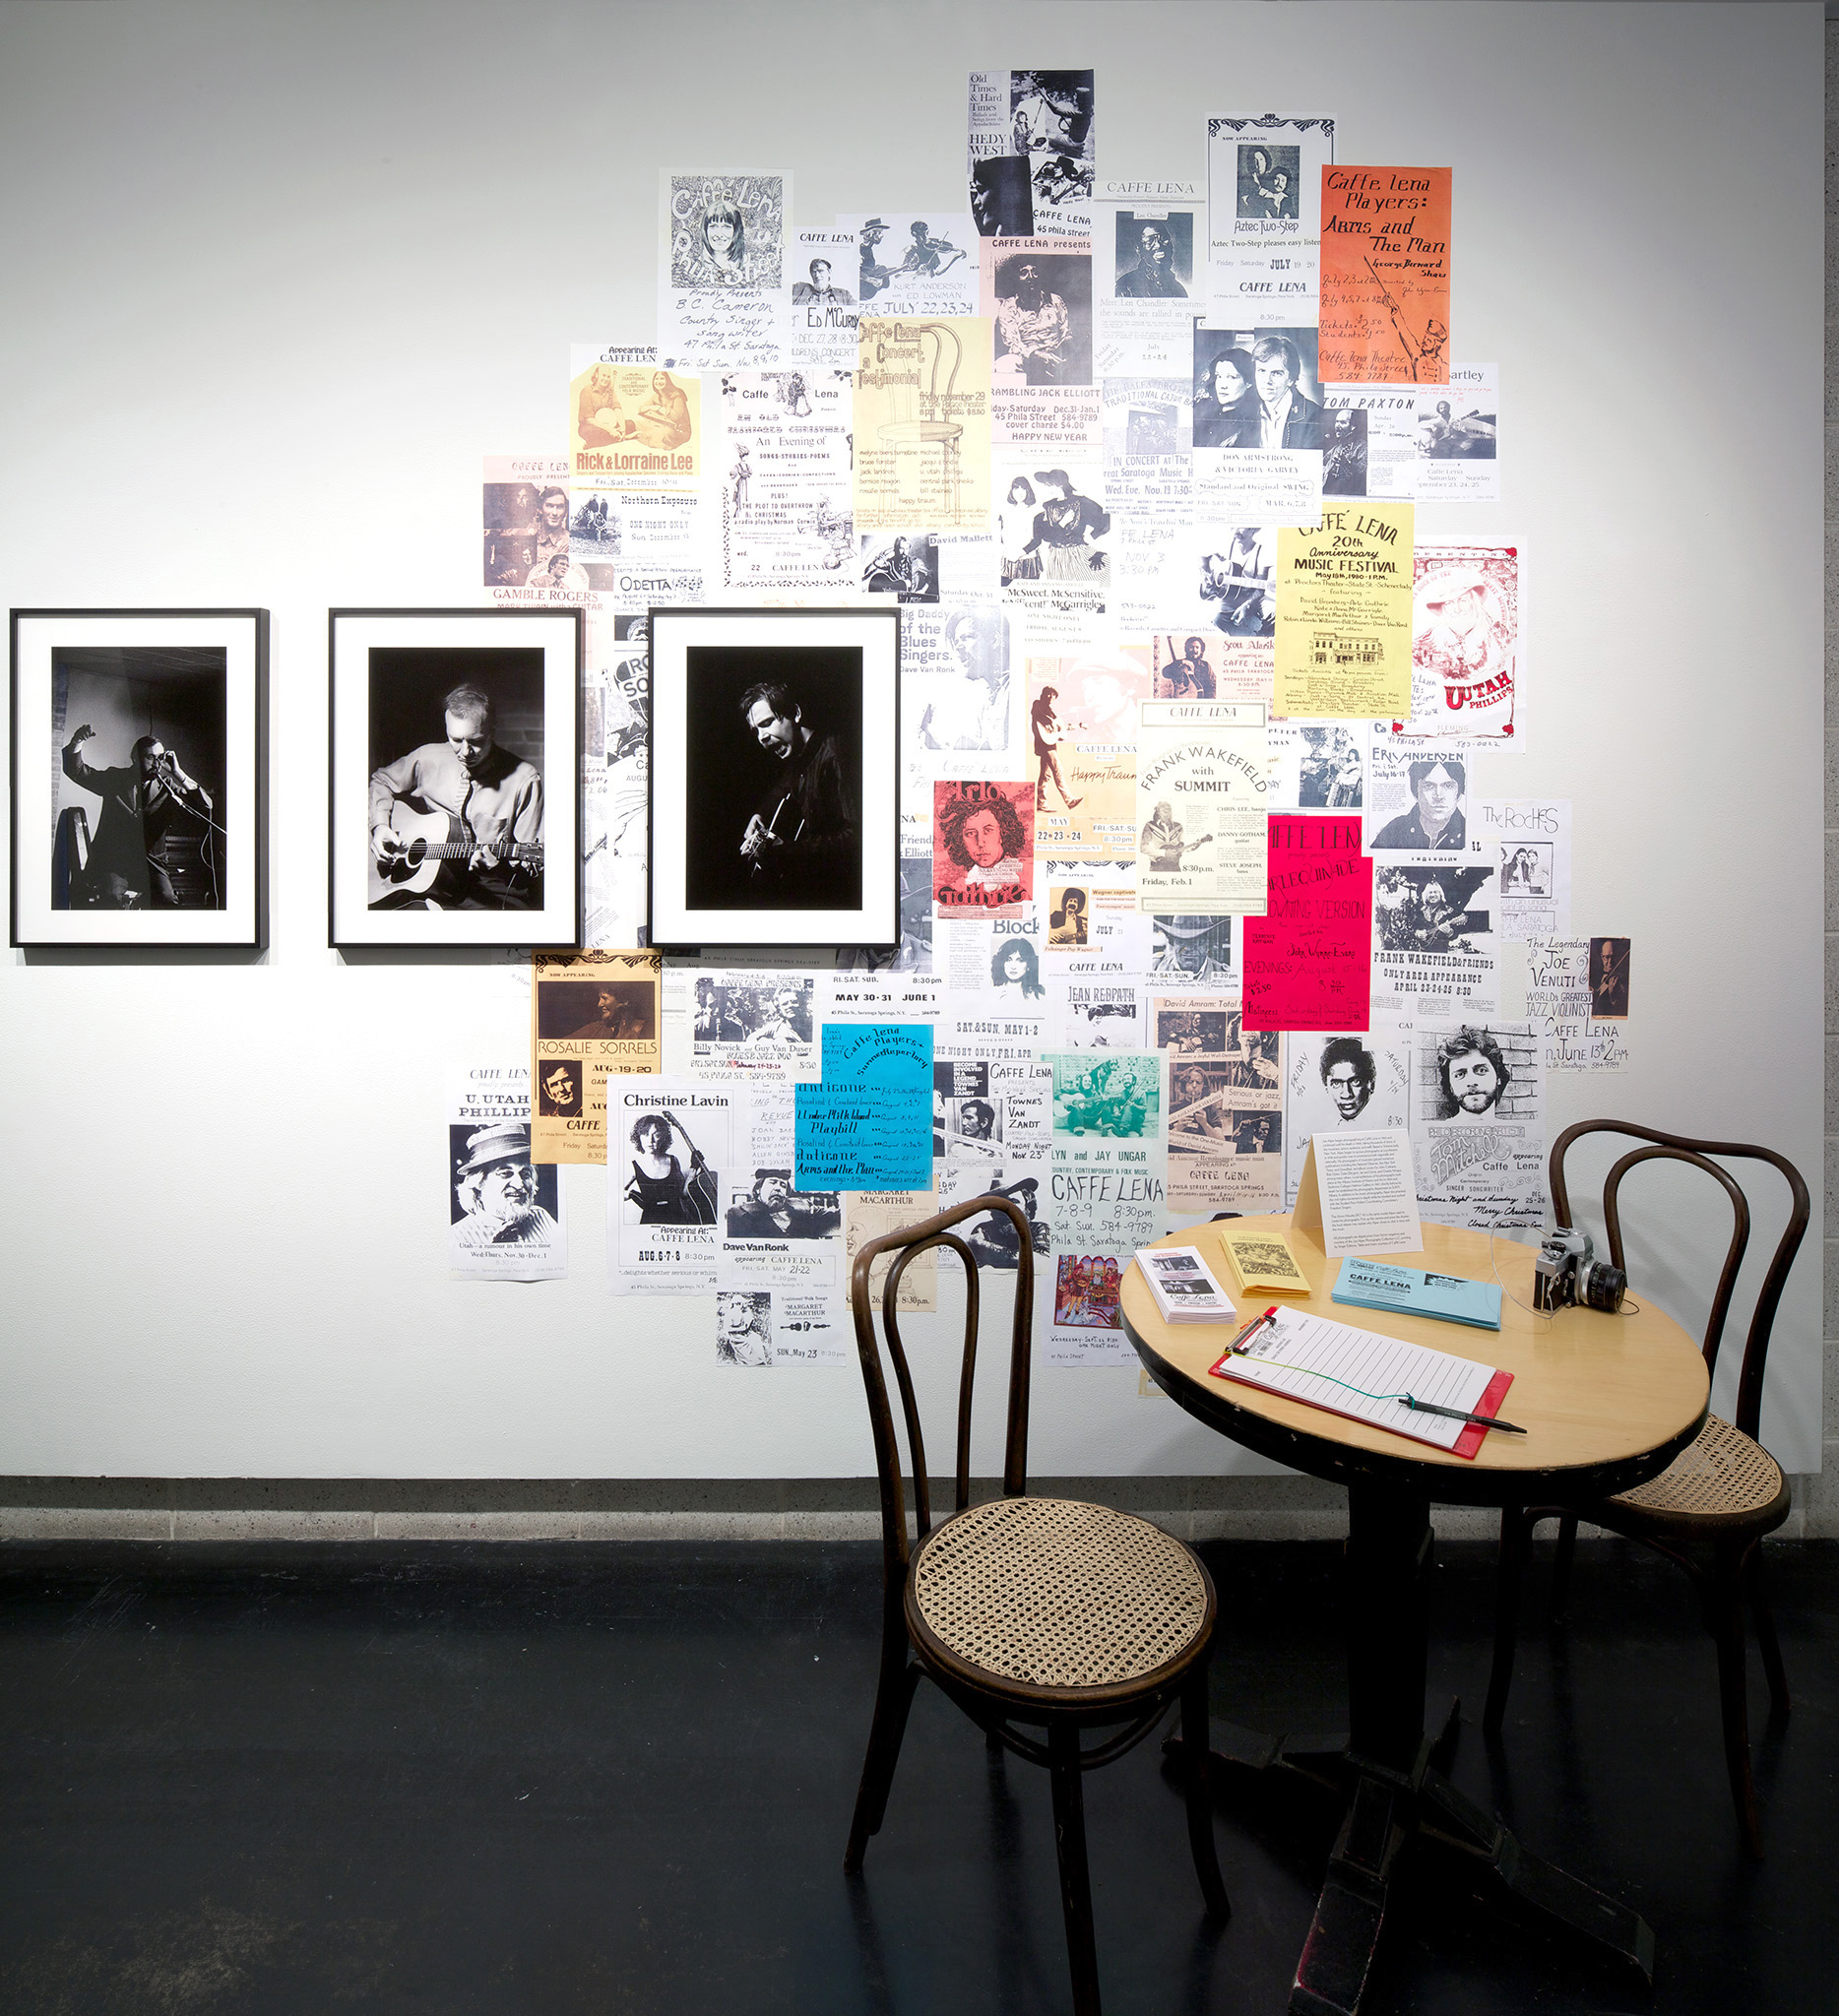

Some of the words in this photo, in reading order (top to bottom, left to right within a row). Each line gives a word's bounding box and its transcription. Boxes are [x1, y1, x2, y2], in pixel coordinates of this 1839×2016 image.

[971, 75, 987, 84] Old
[981, 94, 1002, 102] Hard
[971, 102, 996, 111] Times
[970, 134, 1007, 144] HEDY
[970, 146, 1008, 156] WEST
[1327, 171, 1381, 191] Caffe
[1108, 182, 1152, 193] CAFFE
[1157, 182, 1195, 194] LENA
[1034, 209, 1063, 221] CAFFE
[1234, 220, 1258, 234] Aztec
[1381, 216, 1416, 235] and
[799, 233, 827, 243] CAFFE
[831, 233, 855, 243] LENA
[992, 239, 1021, 248] CAFFE
[1024, 239, 1048, 248] LENA
[1369, 236, 1401, 252] The
[1407, 237, 1446, 254] Man
[1270, 259, 1292, 270] JULY
[1239, 283, 1274, 292] CAFFE
[1279, 283, 1306, 292] LENA
[712, 299, 774, 313] Cameron
[883, 302, 920, 314] JULY
[920, 302, 974, 314] 22,23,24
[600, 354, 634, 363] CAFFE
[742, 390, 769, 399] Caffe
[814, 390, 839, 399] Lena
[1039, 389, 1060, 398] JACK
[1064, 389, 1101, 398] ELLIOTT
[1359, 398, 1415, 410] PAXTON
[1031, 421, 1059, 430] charge
[576, 452, 605, 471] Rick
[614, 452, 668, 471] Lorraine
[670, 453, 693, 471] Lee
[1125, 456, 1161, 467] CONCERT
[1175, 455, 1189, 465] The
[1121, 468, 1156, 478] Saratoga
[1160, 468, 1183, 477] Music
[621, 496, 659, 505] Northern
[662, 496, 698, 506] Exposure
[645, 521, 666, 530] NIGHT
[669, 521, 689, 530] ONLY
[1357, 515, 1398, 545] LENA
[929, 536, 957, 545] David
[1332, 535, 1363, 548] 20th
[1309, 547, 1379, 559] Anniversary
[1295, 558, 1334, 571] MUSIC
[1340, 559, 1399, 573] FESTIVAL
[620, 576, 672, 592] ODETTA
[493, 589, 545, 600] GAMBLE
[549, 592, 599, 602] ROGERS
[918, 609, 950, 621] Daddy
[919, 623, 941, 634] the
[1469, 685, 1513, 709] PHILLIPS
[1170, 707, 1203, 718] CAFFE
[1209, 707, 1237, 718] LENA
[1141, 750, 1186, 790] FRANK
[1188, 746, 1267, 792] WAKEFIELD
[1191, 767, 1214, 776] with
[1174, 781, 1231, 792] SUMMIT
[1142, 878, 1169, 887] Friday,
[1316, 900, 1365, 919] VERSION
[1096, 925, 1112, 935] JULY
[1527, 937, 1545, 949] The
[1373, 953, 1406, 965] FRANK
[1069, 963, 1097, 972] CAFFE
[1101, 963, 1123, 972] LENA
[1430, 972, 1483, 983] APPEARANCE
[1530, 967, 1575, 987] VENUTI
[1067, 985, 1091, 1002] JEAN
[1394, 981, 1419, 992] APRIL
[1421, 983, 1452, 994] 23-24-25
[1457, 986, 1472, 996] 8:30
[835, 993, 859, 1002] MAY
[1560, 991, 1593, 1002] GREATEST
[1526, 1002, 1548, 1017] JAZZ
[1004, 1025, 1024, 1035] MAY
[1584, 1018, 1619, 1038] LENA
[539, 1041, 593, 1054] ROSALIE
[600, 1041, 658, 1054] SORRELS
[693, 1042, 712, 1052] Billy
[754, 1045, 770, 1054] Guy
[948, 1046, 972, 1057] NIGHT
[989, 1063, 1026, 1079] CAFFE
[1029, 1063, 1052, 1078] LENA
[482, 1095, 528, 1103] UTAH
[1229, 1089, 1253, 1098] Serious
[624, 1095, 687, 1106] Christine
[691, 1095, 729, 1106] Lavin
[1074, 1151, 1087, 1162] and
[1095, 1151, 1110, 1162] JAY
[1118, 1152, 1147, 1162] UNGAR
[1483, 1162, 1509, 1171] Caffe
[1516, 1162, 1540, 1170] Lena
[1189, 1170, 1219, 1180] CAFFE
[1225, 1171, 1250, 1181] LENA
[1052, 1174, 1111, 1202] CAFFE
[1116, 1175, 1164, 1202] LENA
[1055, 1203, 1093, 1218] 7-8-9
[1100, 1221, 1153, 1233] 584-9789
[723, 1243, 745, 1252] Dave
[765, 1243, 789, 1252] Ronk
[1090, 1235, 1127, 1253] Saratoga
[1350, 1273, 1381, 1285] CAFFE
[1383, 1278, 1412, 1291] LENA
